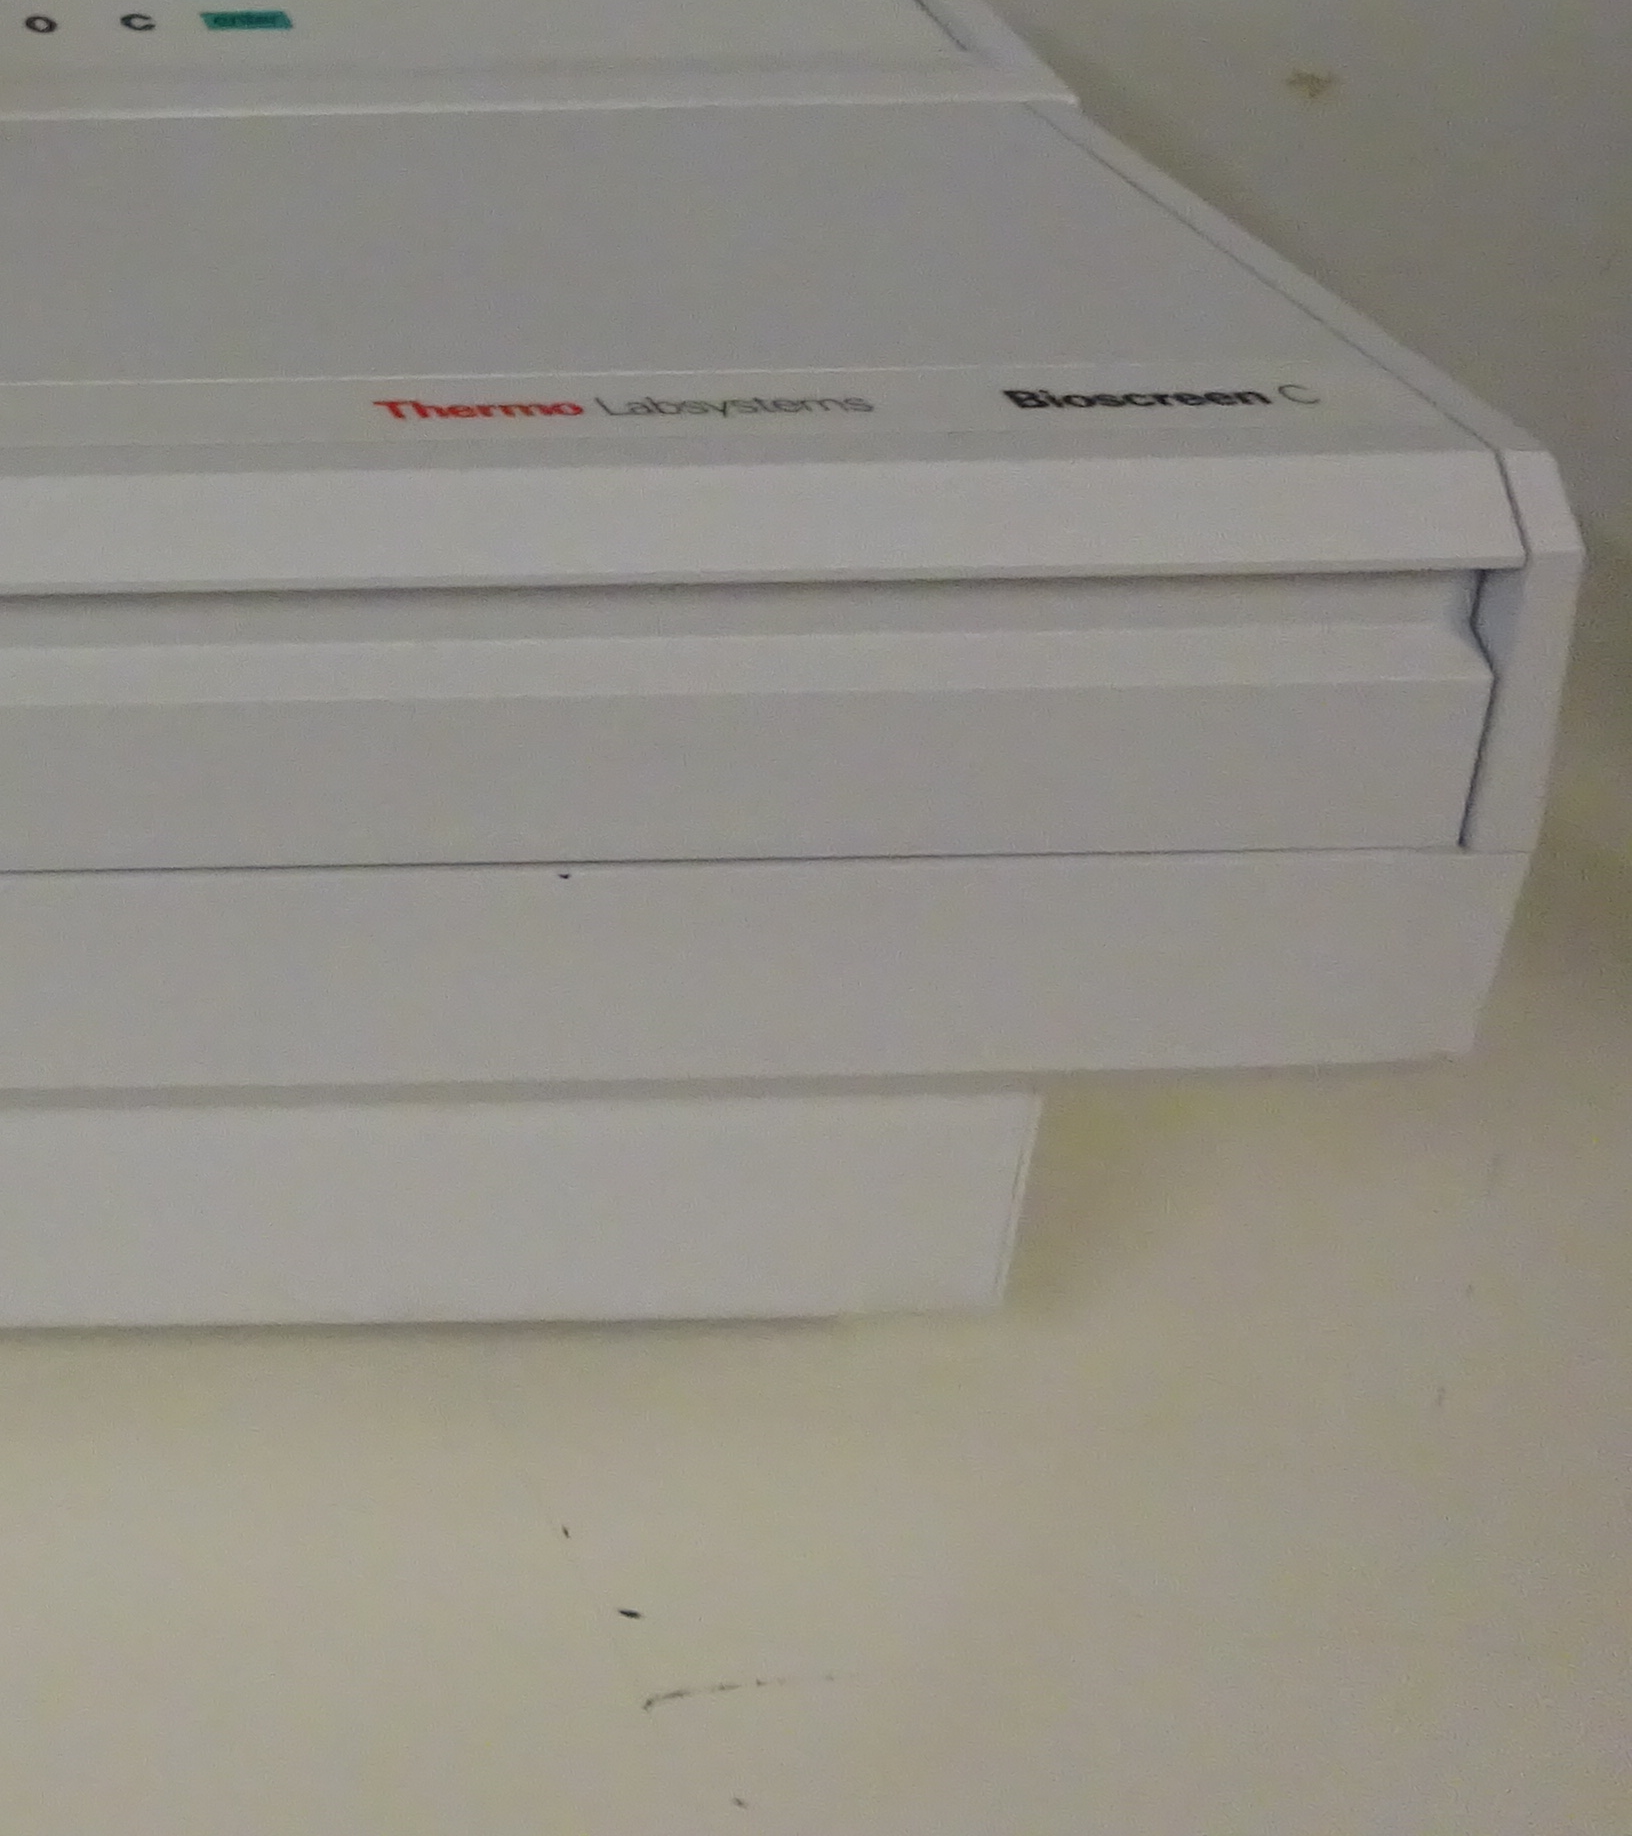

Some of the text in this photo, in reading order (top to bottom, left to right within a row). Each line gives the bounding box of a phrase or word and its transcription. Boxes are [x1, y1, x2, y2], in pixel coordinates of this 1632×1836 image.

[120, 13, 156, 32] C
[372, 396, 874, 421] Thermo Labsystems
[1002, 384, 1321, 409] Bioscreen C
